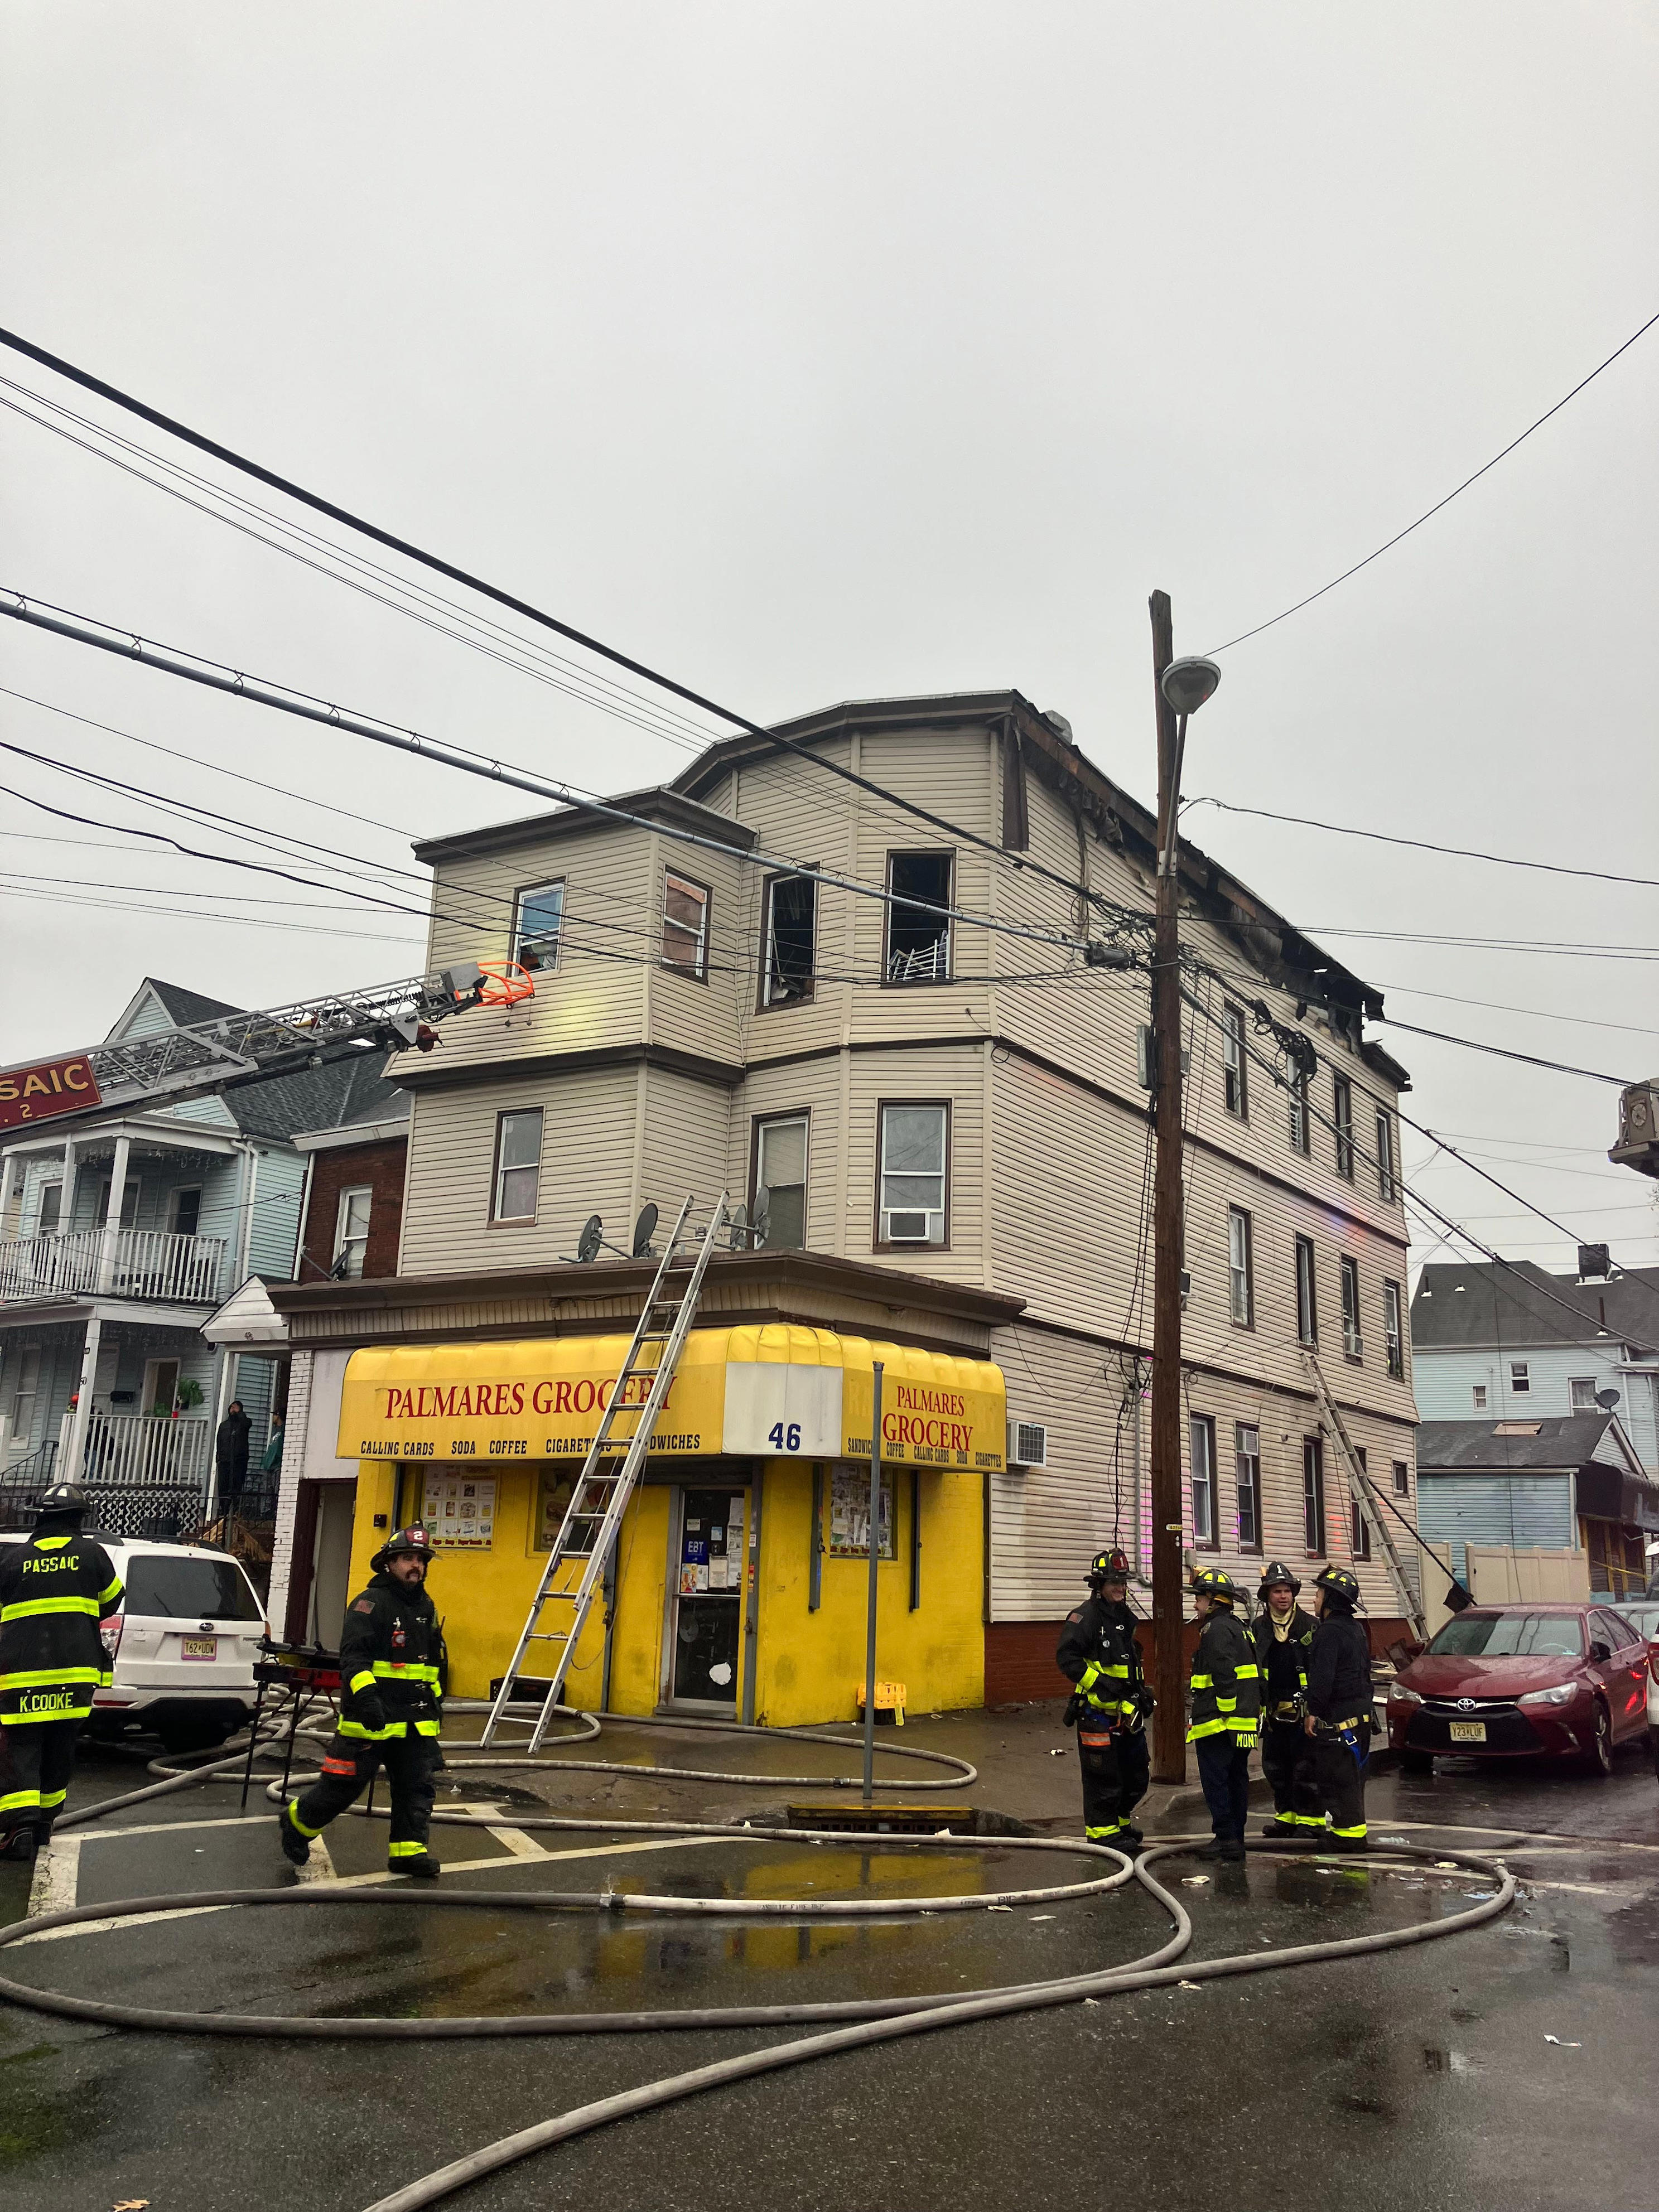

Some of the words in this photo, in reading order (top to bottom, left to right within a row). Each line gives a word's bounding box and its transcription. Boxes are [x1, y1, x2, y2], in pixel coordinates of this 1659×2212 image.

[20, 1104, 32, 1118] 2
[385, 1382, 525, 1418] PALMARES
[897, 1385, 964, 1417] PALMARES
[768, 1422, 801, 1451] 46
[882, 1413, 973, 1451] GROCERY
[361, 1441, 399, 1455] CALLING
[404, 1442, 434, 1455] CARDS
[451, 1441, 475, 1455] SODA
[489, 1440, 527, 1455] COFFEE
[546, 1437, 611, 1453] CIGARETS
[848, 1437, 874, 1455] SANDWIC
[886, 1442, 904, 1458] COFFEE
[914, 1445, 933, 1461] CALLING
[935, 1448, 949, 1464] CARDS
[957, 1450, 968, 1464] SODA
[976, 1451, 1001, 1468] CIGARETTES
[413, 1530, 423, 1540] 2
[688, 1540, 704, 1553] EBT
[23, 1556, 79, 1573] PASSAIC
